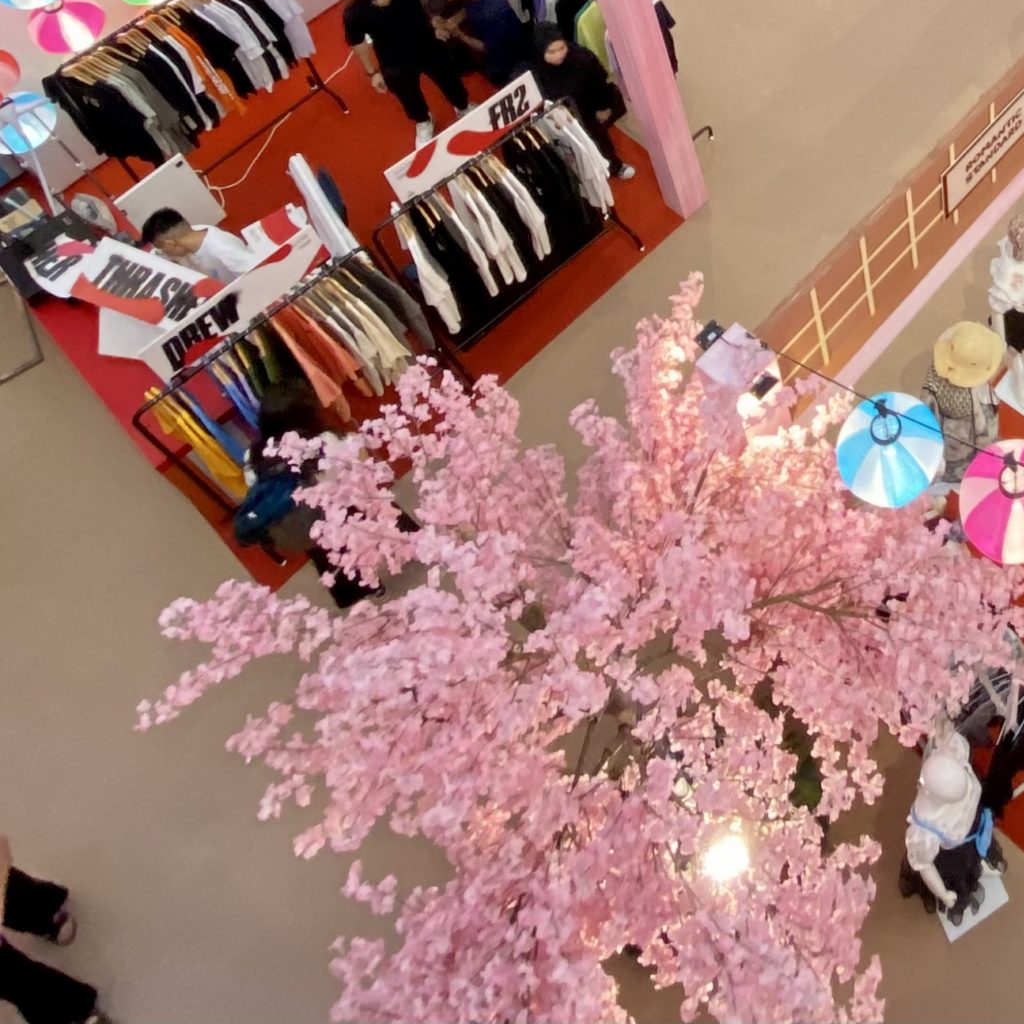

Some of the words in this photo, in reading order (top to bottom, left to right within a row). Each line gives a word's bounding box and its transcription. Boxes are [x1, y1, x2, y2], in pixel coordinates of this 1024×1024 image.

[488, 84, 530, 131] FR2
[965, 107, 1022, 173] ROMANTIC
[965, 119, 1023, 184] STANDARD
[162, 292, 240, 371] DREW
